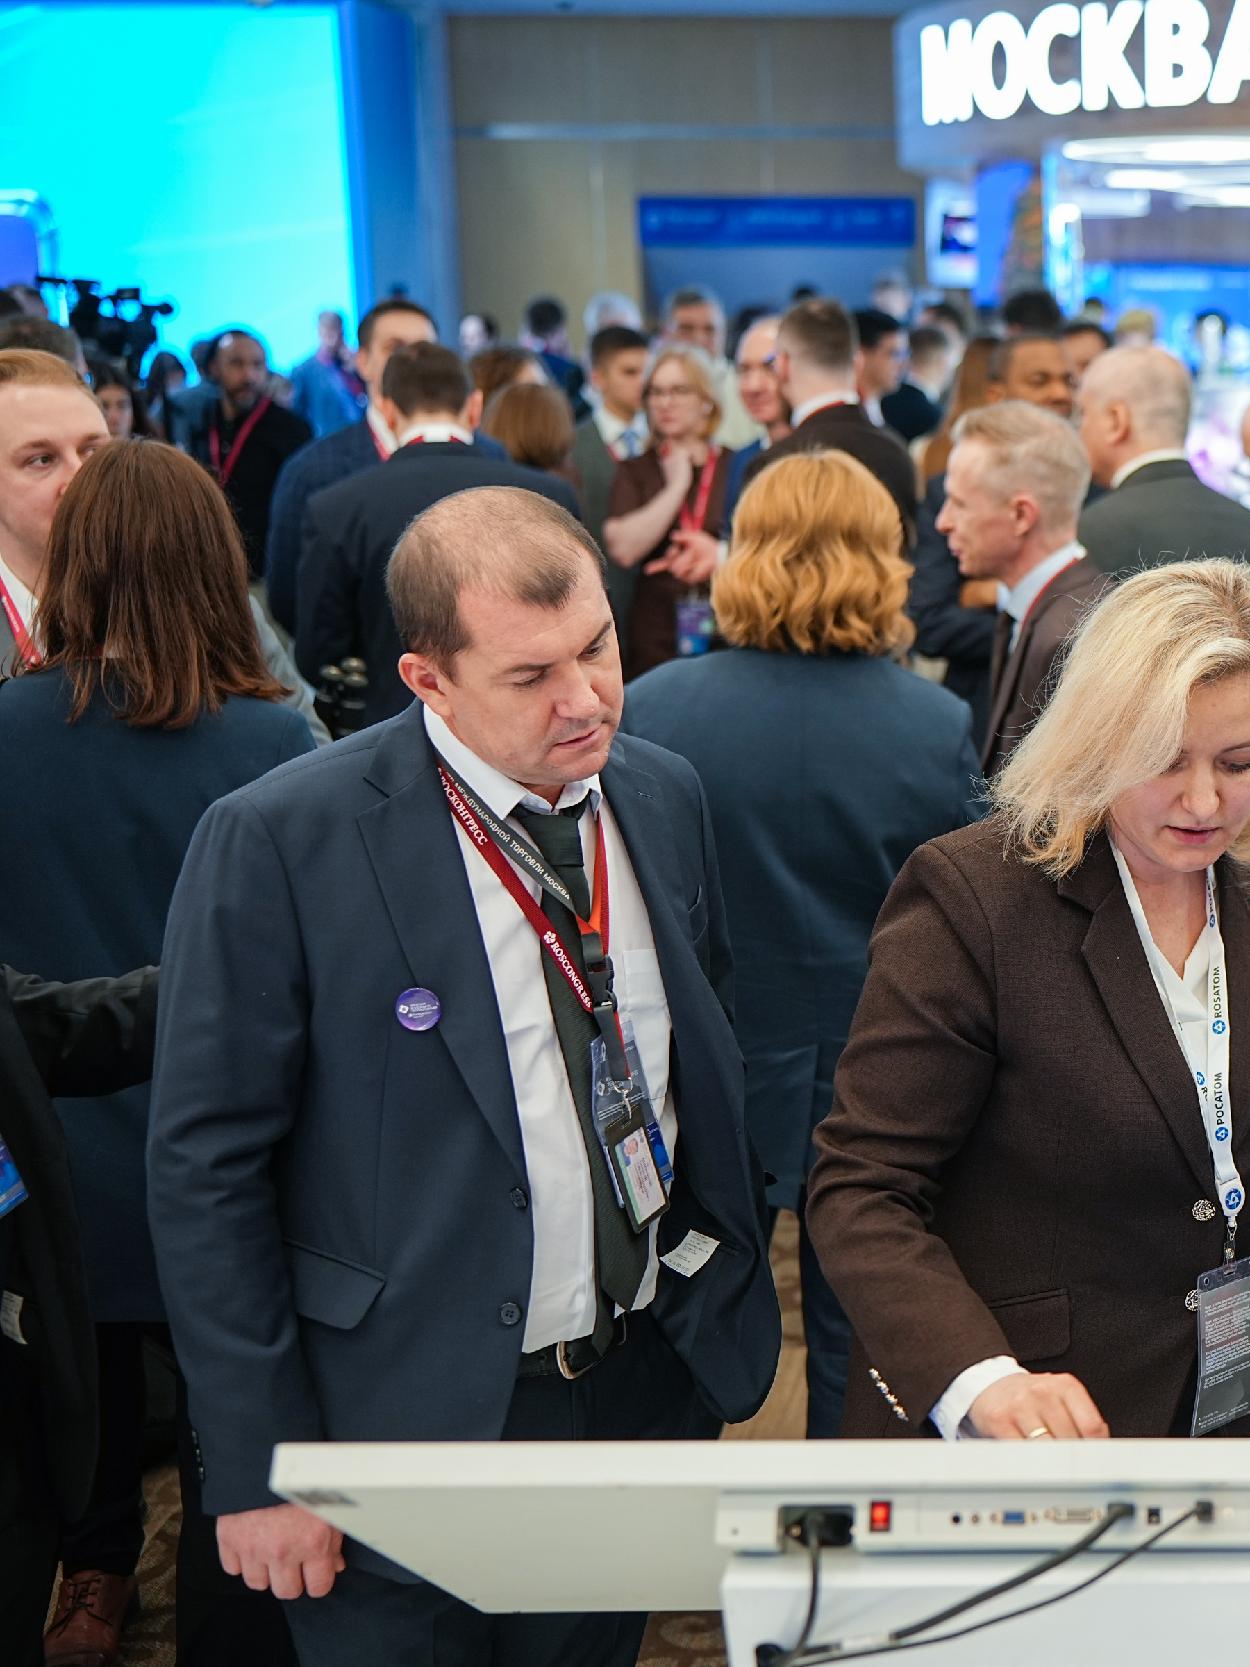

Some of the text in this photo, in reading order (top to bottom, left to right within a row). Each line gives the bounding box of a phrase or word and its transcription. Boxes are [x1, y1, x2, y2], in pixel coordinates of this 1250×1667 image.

[510, 839, 544, 875] ТОРГОВЛИ
[543, 872, 571, 900] МОСКВА
[551, 941, 592, 1008] ROSCONGRESS
[1213, 966, 1222, 1019] ROSATOM
[1214, 1072, 1225, 1126] РОСАТОМ
